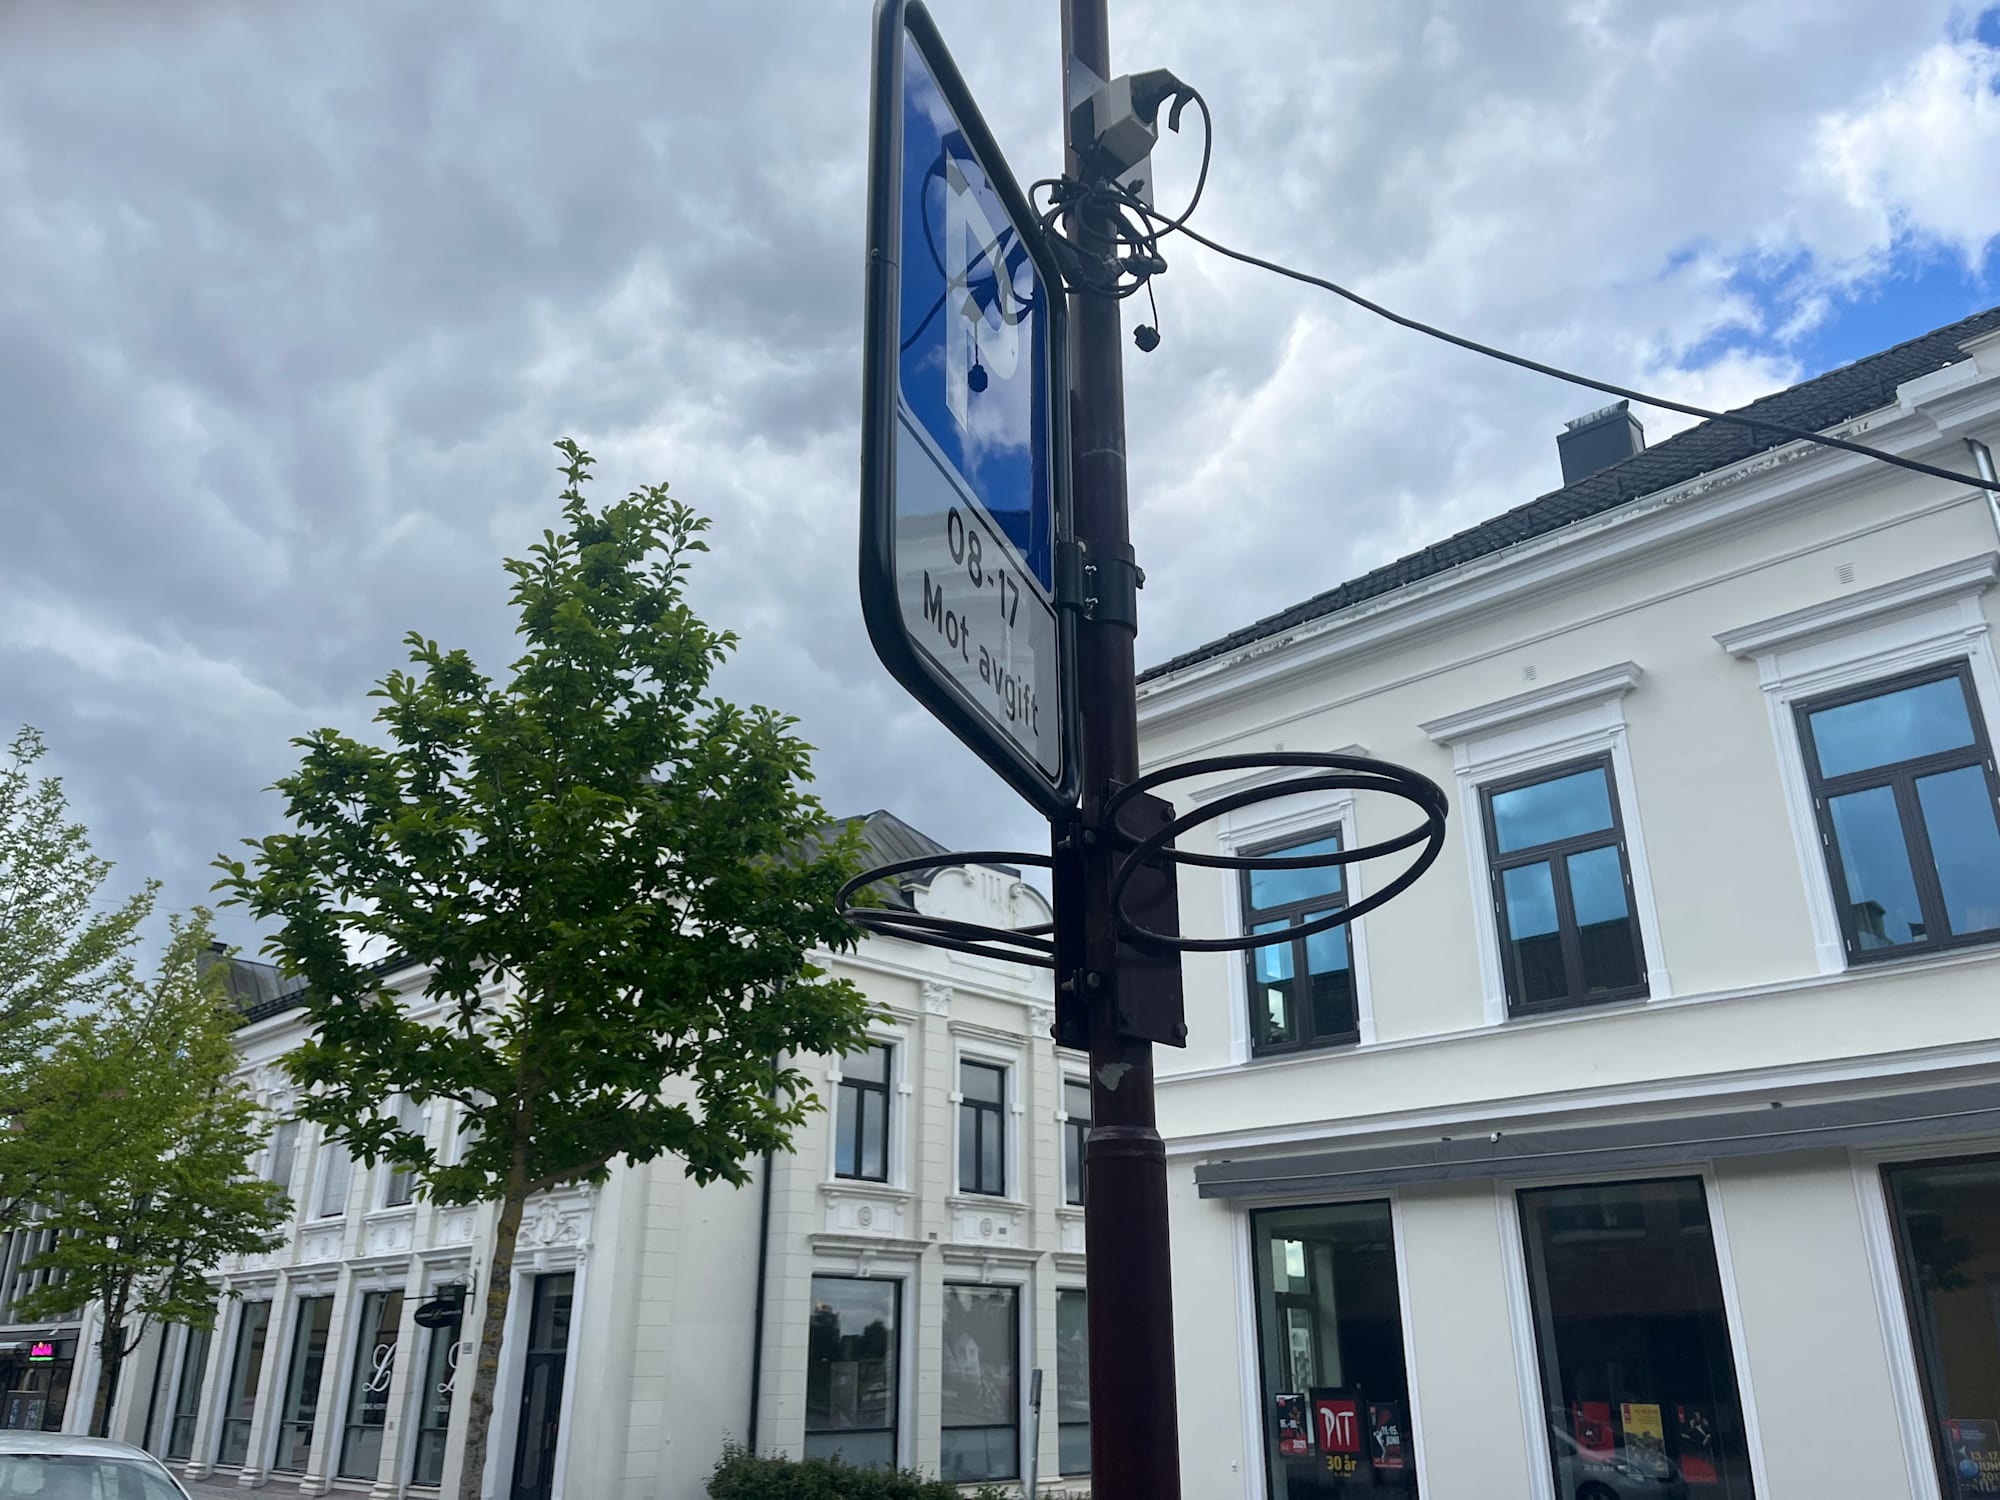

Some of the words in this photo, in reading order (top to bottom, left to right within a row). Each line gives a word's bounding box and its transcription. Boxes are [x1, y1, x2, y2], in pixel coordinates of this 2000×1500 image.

[947, 505, 1020, 629] 08-17
[923, 569, 969, 664] Mot
[979, 644, 1040, 737] avgift
[1320, 1407, 1355, 1448] PIT
[1326, 1455, 1342, 1471] 30
[1343, 1454, 1357, 1471] år
